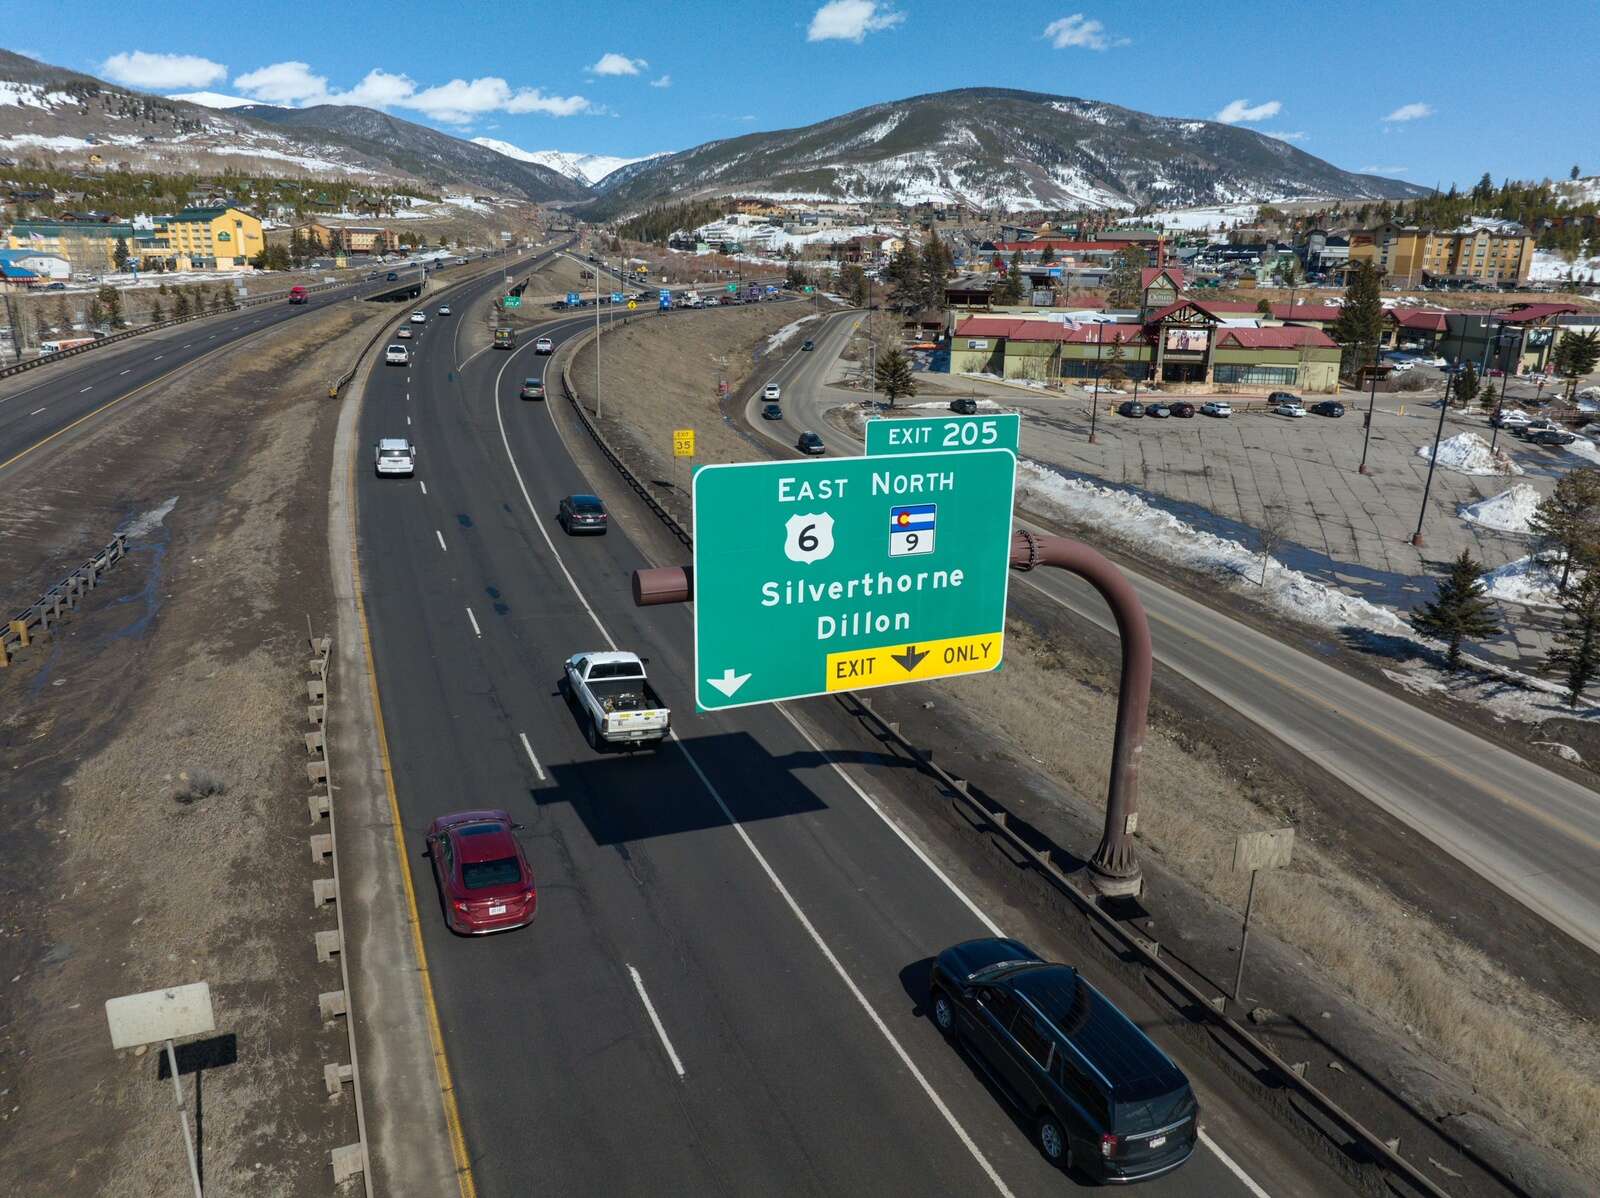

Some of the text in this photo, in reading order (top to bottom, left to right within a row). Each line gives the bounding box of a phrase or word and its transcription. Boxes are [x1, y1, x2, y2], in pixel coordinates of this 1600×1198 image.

[676, 441, 691, 450] 35
[889, 421, 998, 447] EXIT 205
[778, 471, 954, 503] EAST NORTH
[798, 524, 819, 552] 6
[905, 533, 919, 552] 9
[761, 568, 964, 607] Silverthorne
[817, 611, 910, 640] Dillon
[836, 641, 993, 679] EXIT ONLY
